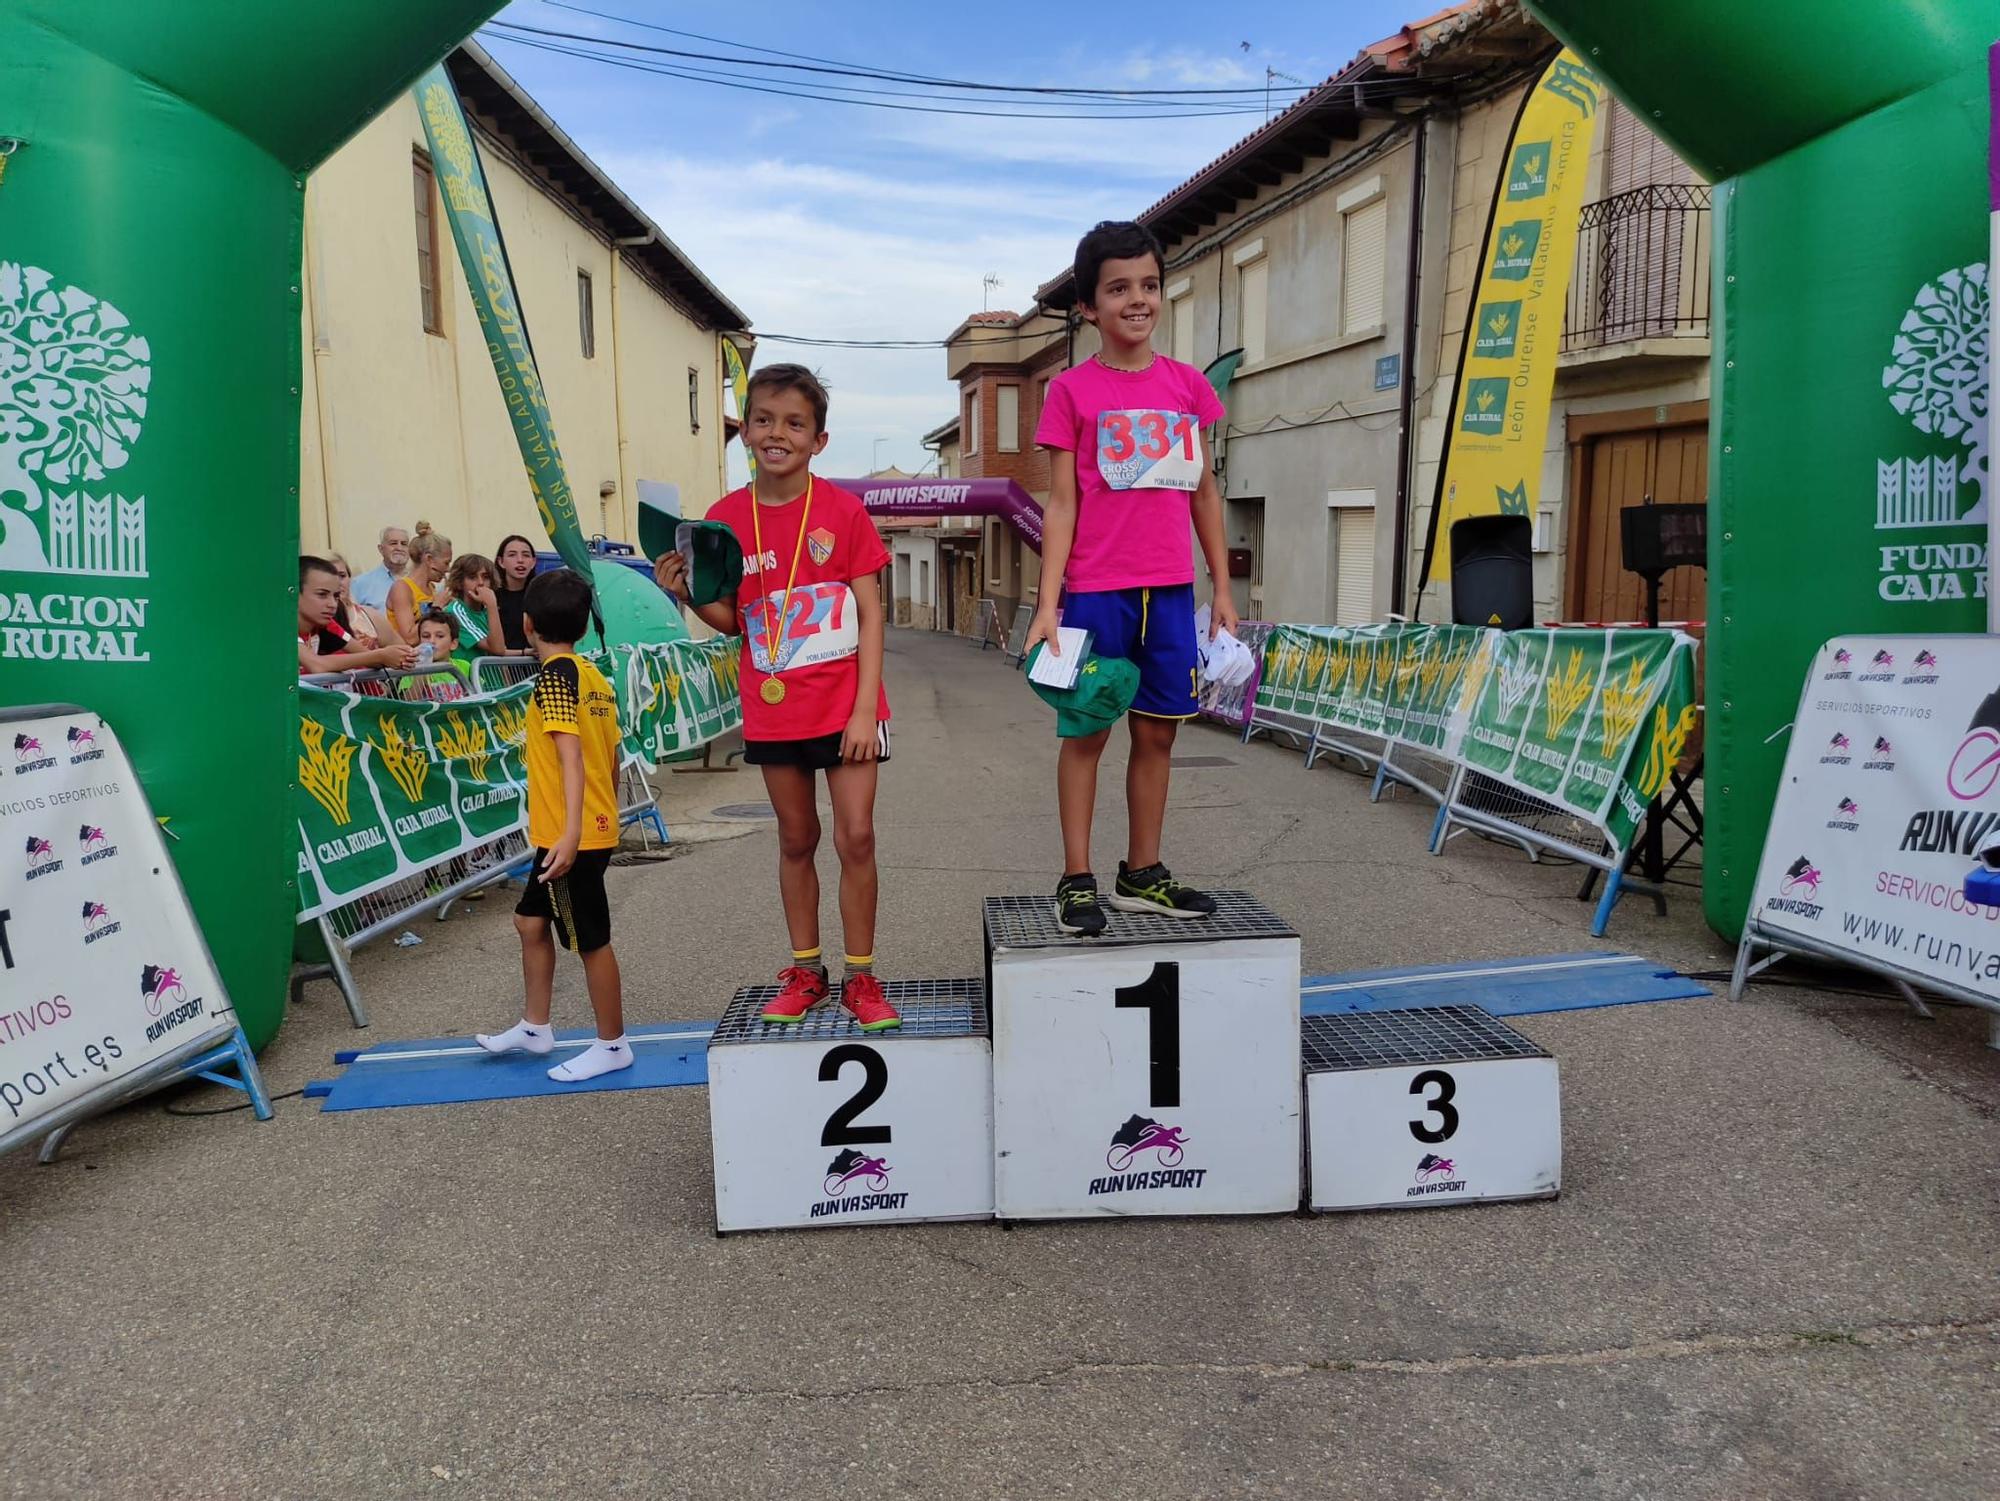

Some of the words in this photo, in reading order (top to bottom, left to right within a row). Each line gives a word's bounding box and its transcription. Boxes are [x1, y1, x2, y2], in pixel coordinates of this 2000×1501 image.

[1514, 312, 1538, 388] Ourense
[489, 341, 551, 468] VALLADOLID
[1506, 400, 1526, 442] León
[1103, 414, 1194, 461] 331
[551, 483, 577, 529] LEÓN
[742, 549, 777, 577] AMUS
[1878, 573, 1966, 602] CAJA
[751, 586, 848, 647] 327
[2, 627, 150, 662] RURAL
[1864, 703, 1933, 720] DEPORTIVOS
[49, 782, 120, 806] DEPORTIVOS
[461, 794, 485, 814] CAJA
[487, 786, 518, 808] RURAL
[395, 813, 420, 837] CAJA
[419, 803, 452, 830] RURAL
[1899, 810, 2000, 862] RUNV
[317, 839, 350, 865] CAJA
[348, 825, 387, 856] RURAL
[1115, 962, 1181, 1108] 1
[818, 1043, 892, 1147] 2
[1409, 1069, 1460, 1144] 3
